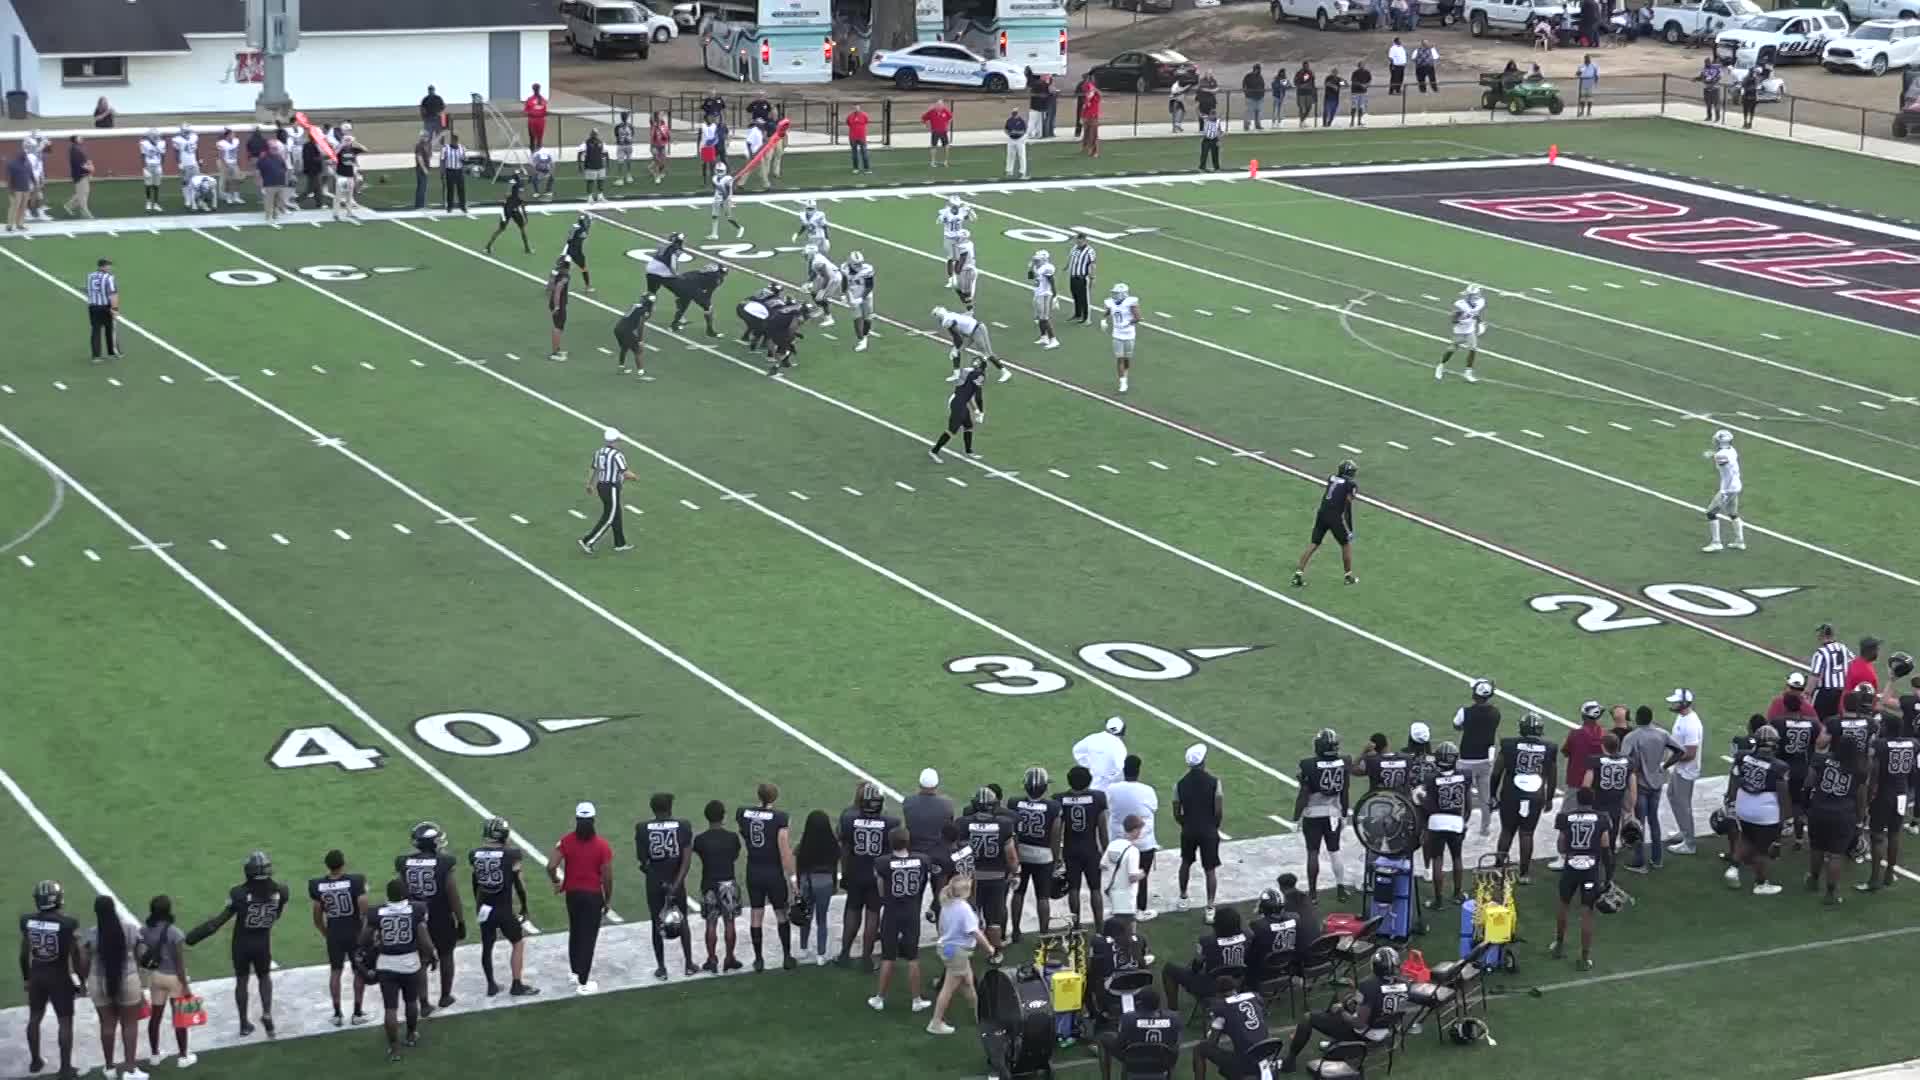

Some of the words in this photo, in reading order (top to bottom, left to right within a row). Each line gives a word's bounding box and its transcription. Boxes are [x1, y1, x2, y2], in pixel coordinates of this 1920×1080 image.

[1529, 582, 1759, 633] 20
[947, 641, 1195, 695] 30
[268, 710, 534, 771] 40
[1070, 805, 1087, 832] 9
[1570, 822, 1596, 849] 17
[649, 829, 680, 859] 24
